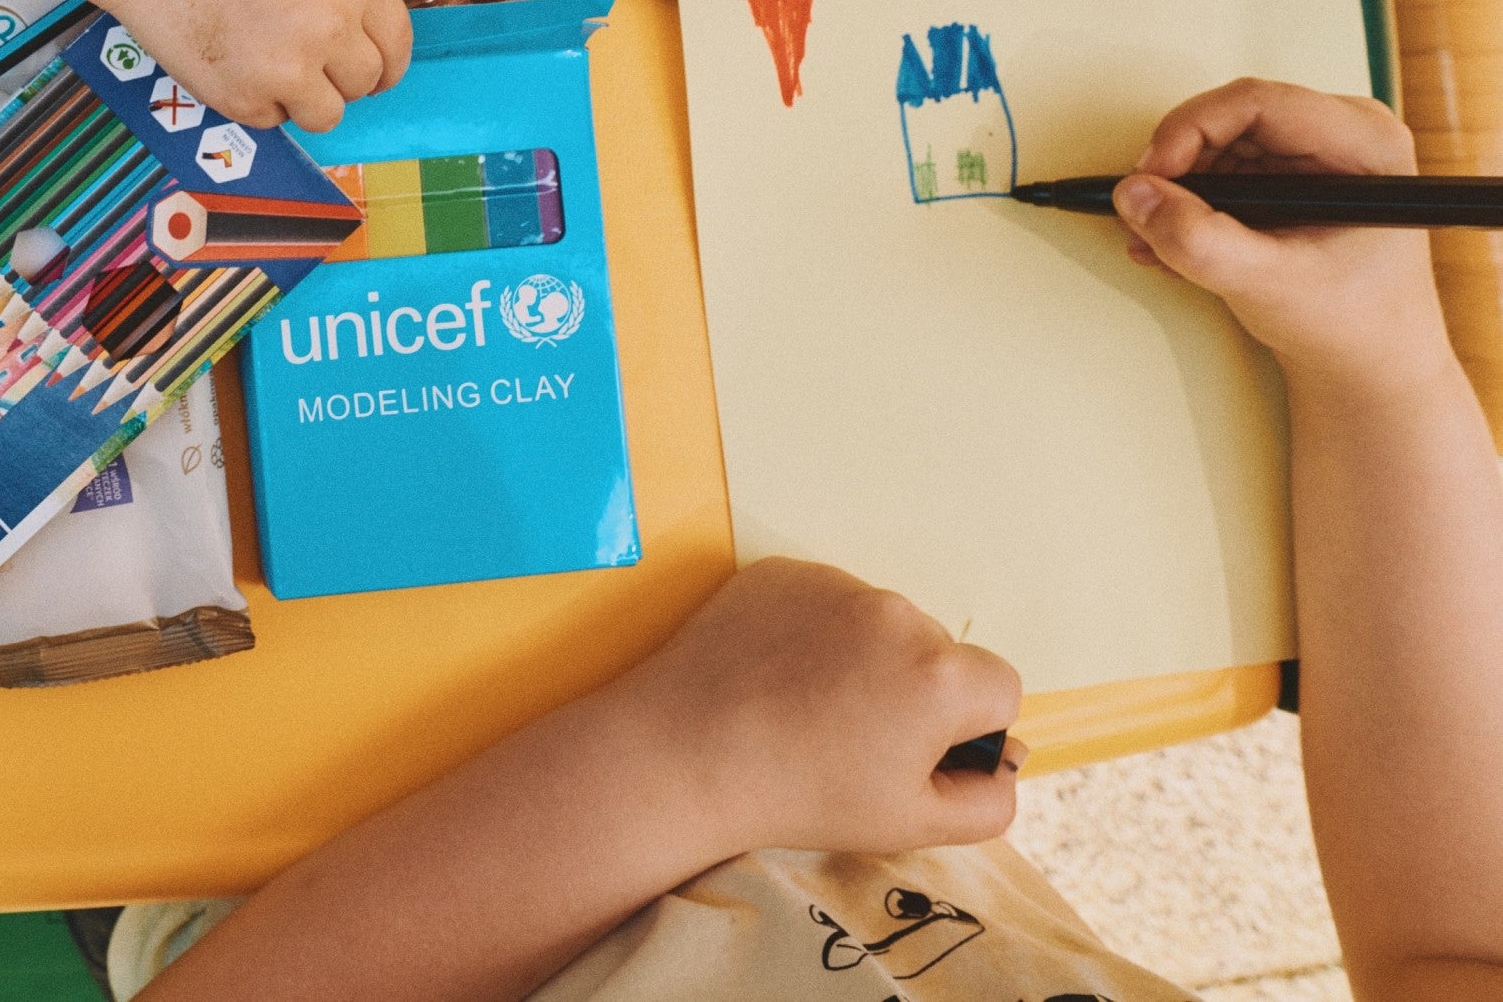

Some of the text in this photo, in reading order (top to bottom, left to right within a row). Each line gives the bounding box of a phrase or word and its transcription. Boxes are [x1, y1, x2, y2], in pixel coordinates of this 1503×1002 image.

[280, 279, 491, 365] unicef
[298, 373, 575, 423] MODELING CLAY
